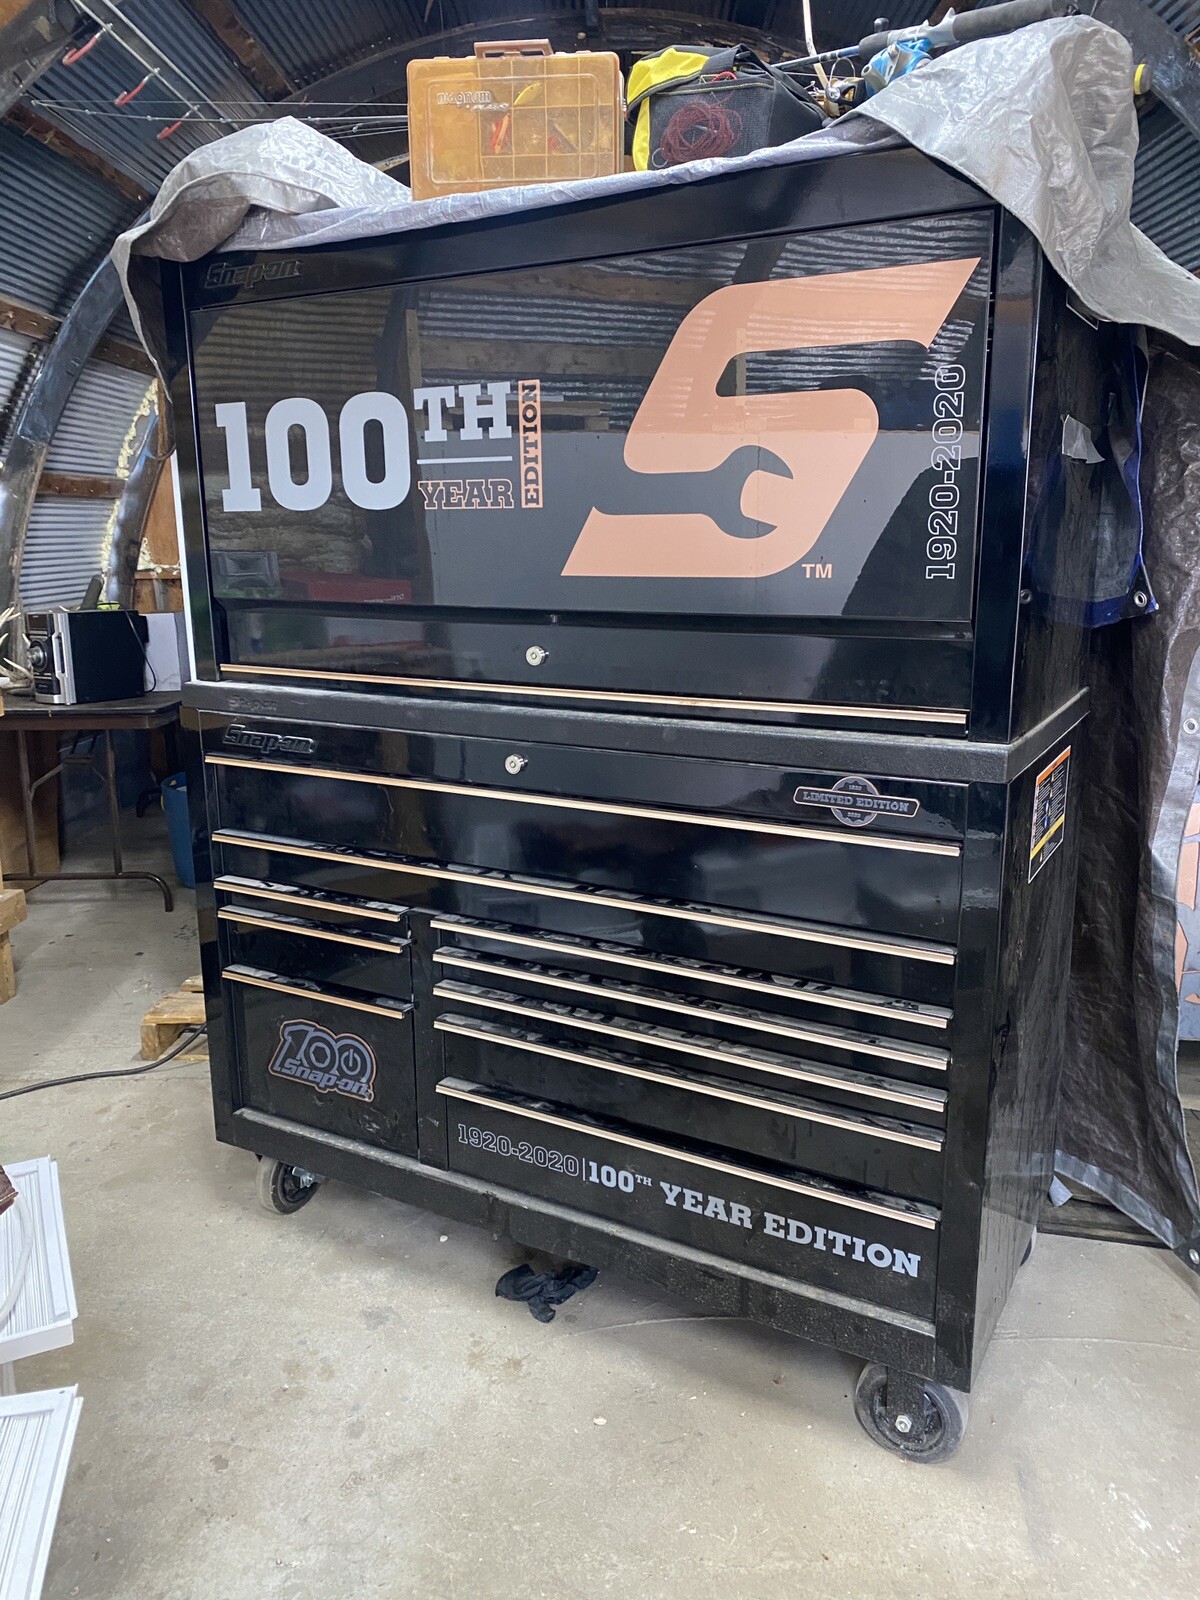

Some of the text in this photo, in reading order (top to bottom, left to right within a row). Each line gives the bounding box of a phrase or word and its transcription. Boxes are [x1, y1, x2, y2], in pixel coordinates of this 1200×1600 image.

[214, 380, 513, 512] 100 TH
[417, 478, 515, 510] YEAR
[521, 381, 541, 507] EDITION
[925, 364, 966, 580] 1920-2020
[801, 563, 833, 579] TM
[802, 791, 909, 812] LIMITED EDITION
[457, 1123, 580, 1177] 1920-2020
[659, 1181, 753, 1230] YEAR
[762, 1212, 921, 1278] EDITION
